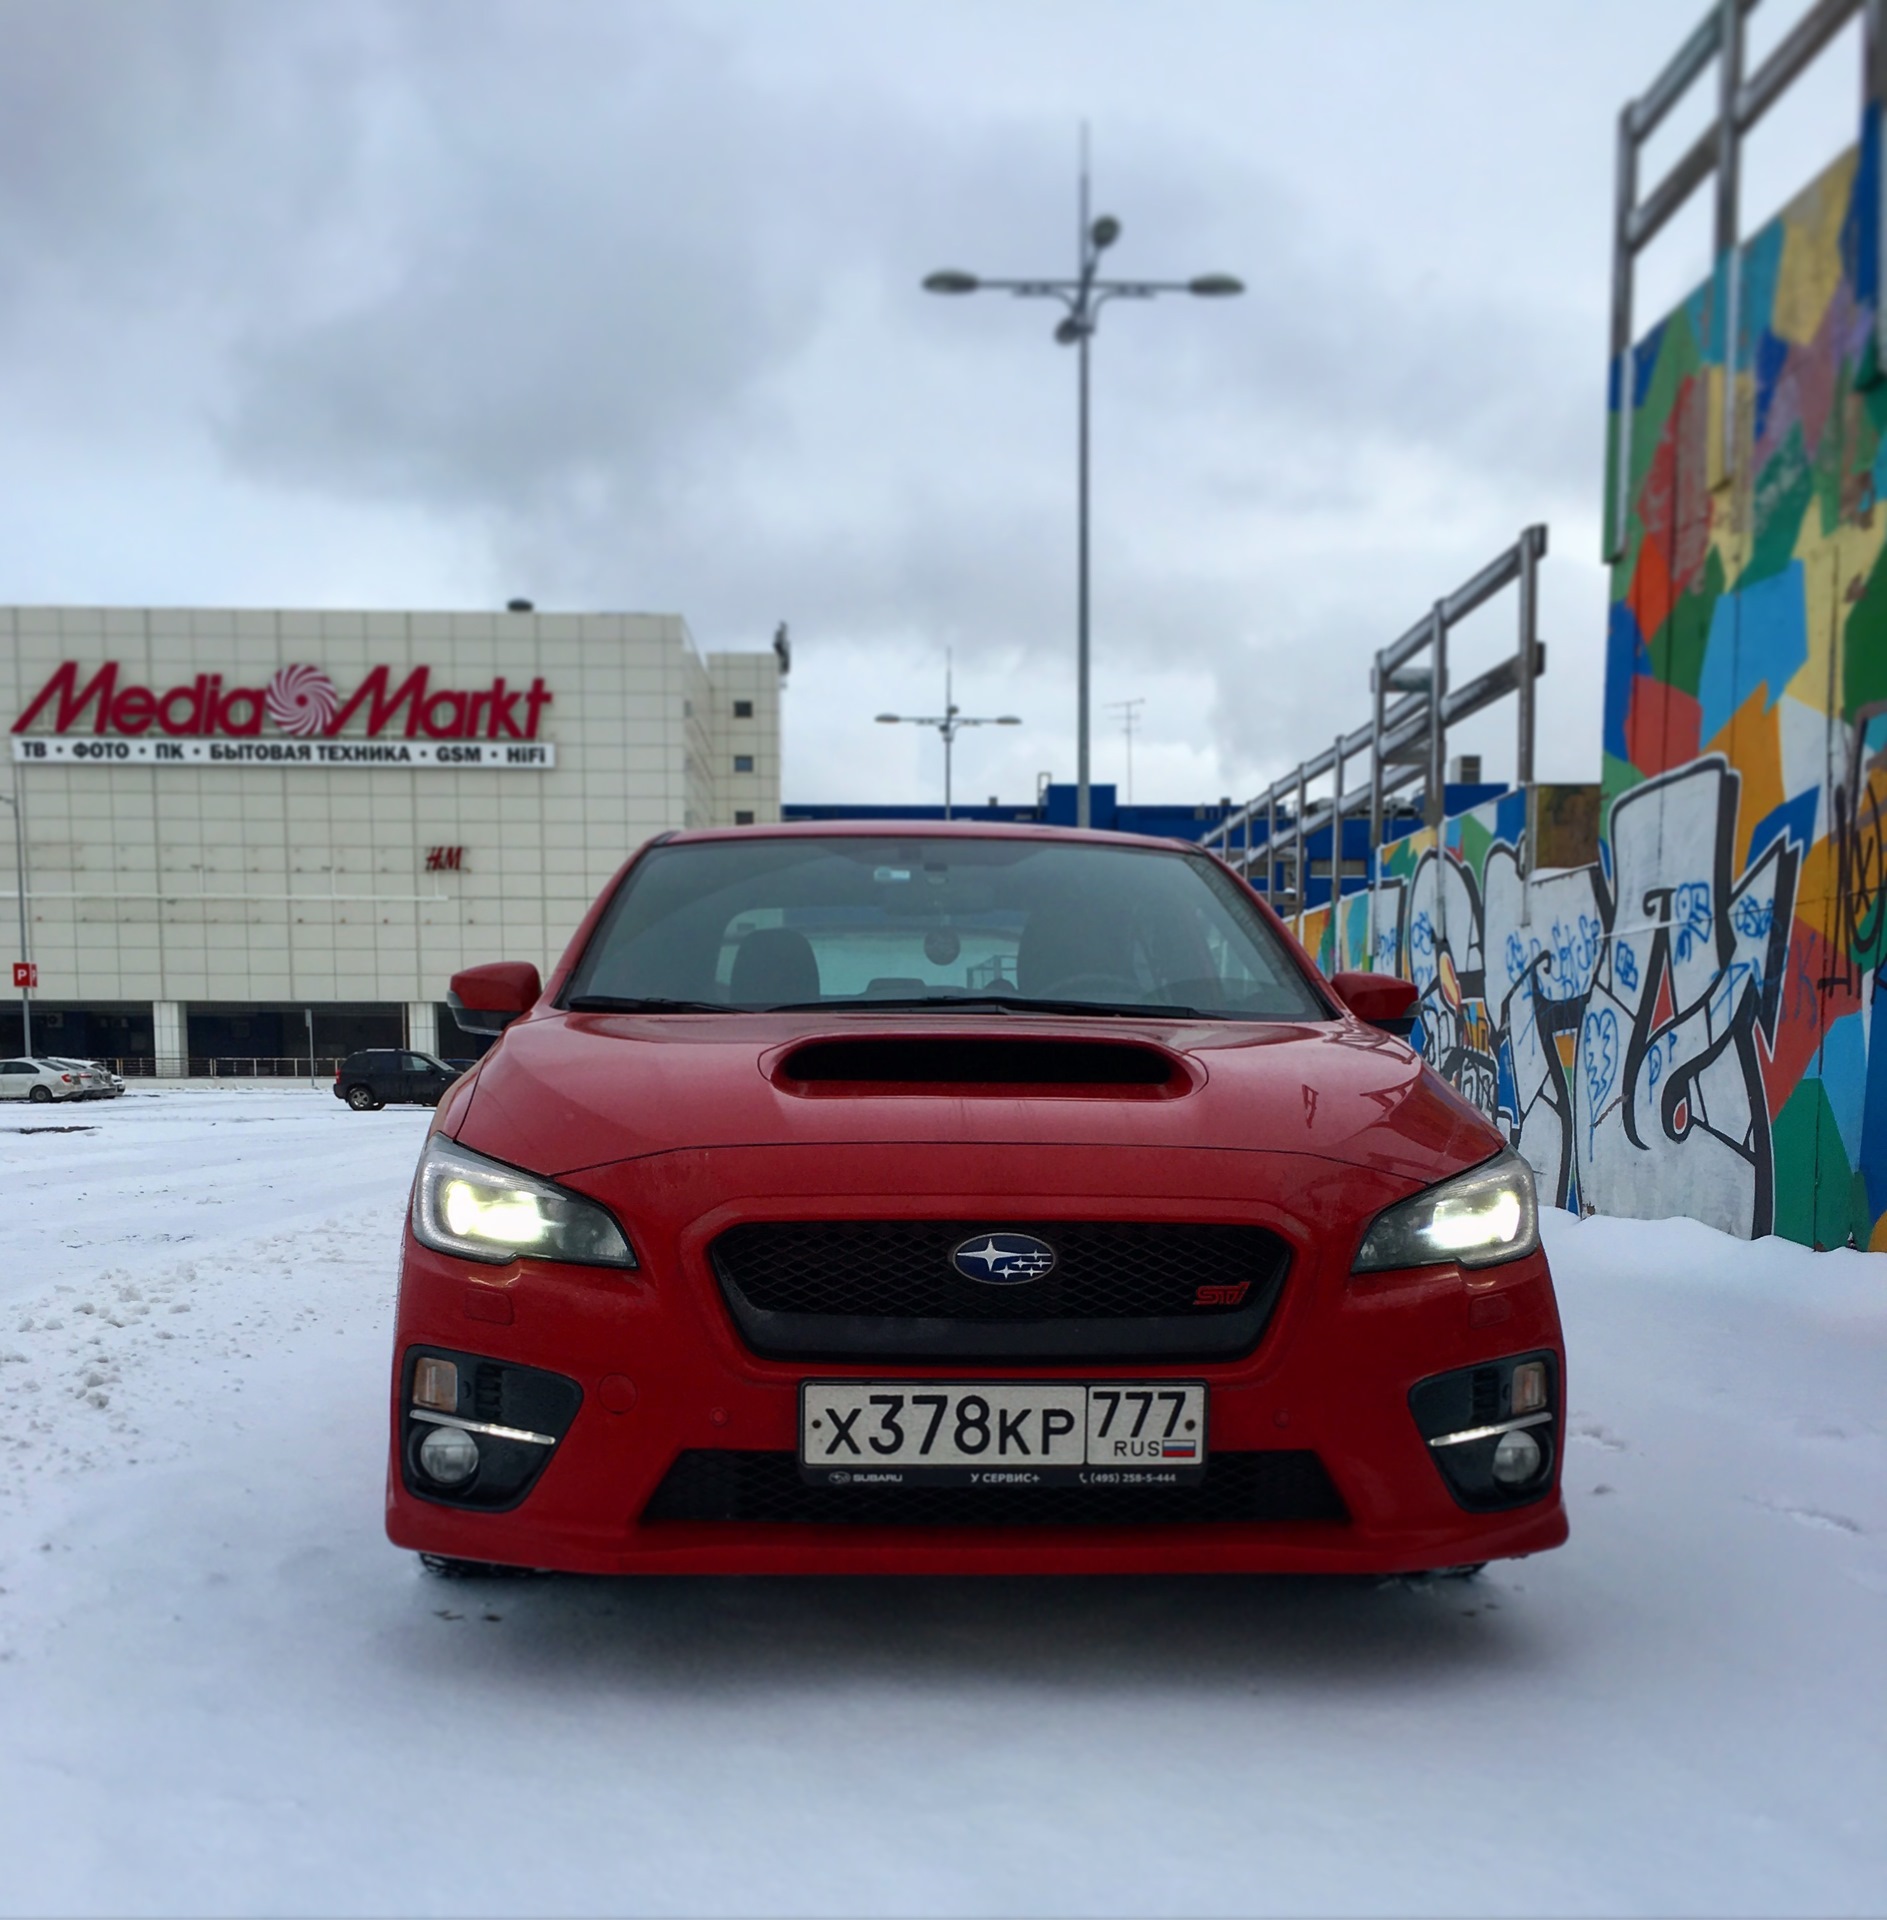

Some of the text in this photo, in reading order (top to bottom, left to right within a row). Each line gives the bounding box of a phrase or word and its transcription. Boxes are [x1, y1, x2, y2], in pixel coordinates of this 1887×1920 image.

[10, 661, 553, 739] Media Markt
[22, 742, 47, 758] ТВ
[72, 743, 130, 759] ФОТО
[155, 743, 184, 760] ПК
[209, 743, 311, 761] БЫТОВАЯ
[317, 745, 411, 762] ТЕХНИКА
[436, 746, 482, 763] GSM
[1093, 1391, 1187, 1438] 777
[1114, 1440, 1160, 1457] RUS
[852, 1473, 903, 1483] SUBARU
